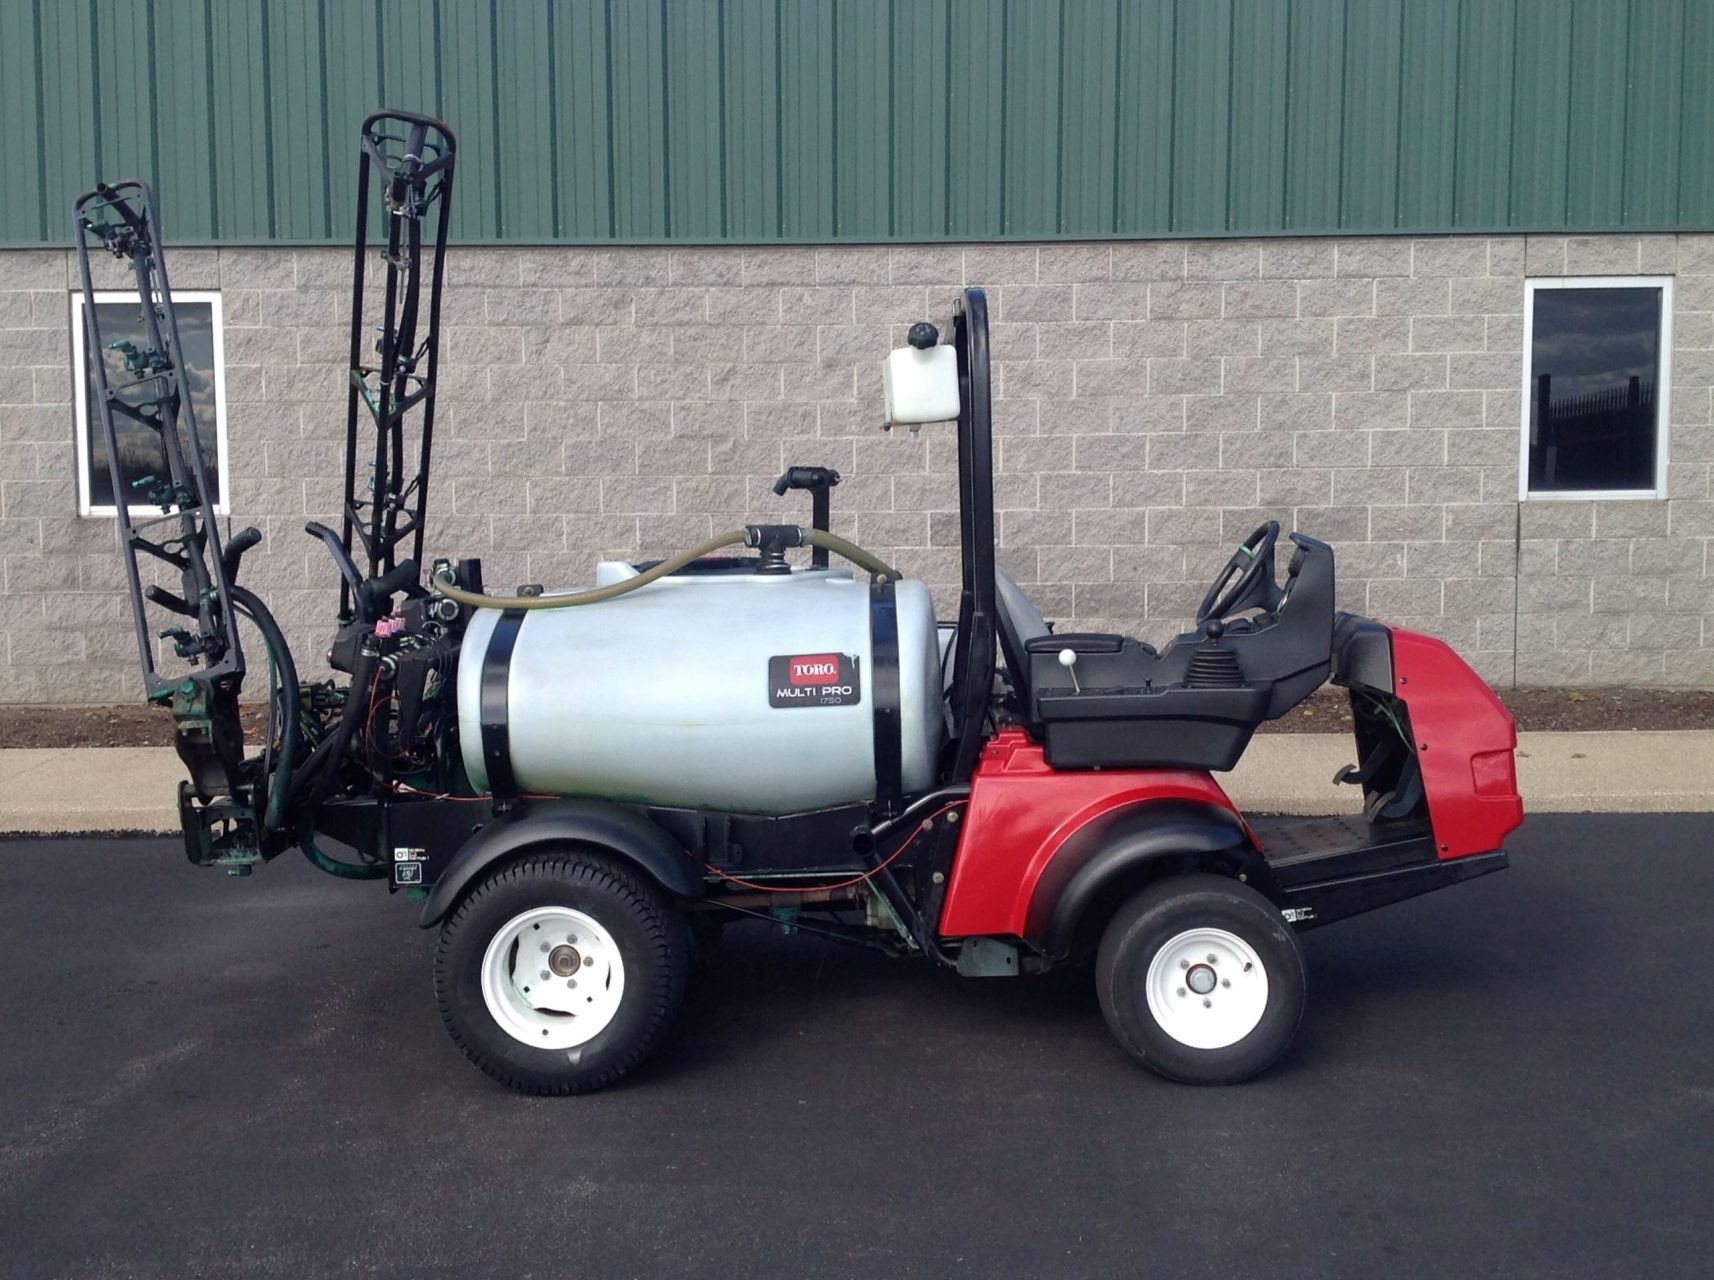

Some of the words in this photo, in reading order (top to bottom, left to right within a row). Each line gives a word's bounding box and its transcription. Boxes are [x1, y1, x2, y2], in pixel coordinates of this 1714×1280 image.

[794, 663, 834, 676] TORO
[776, 687, 816, 698] MULTI
[822, 686, 852, 696] PRO
